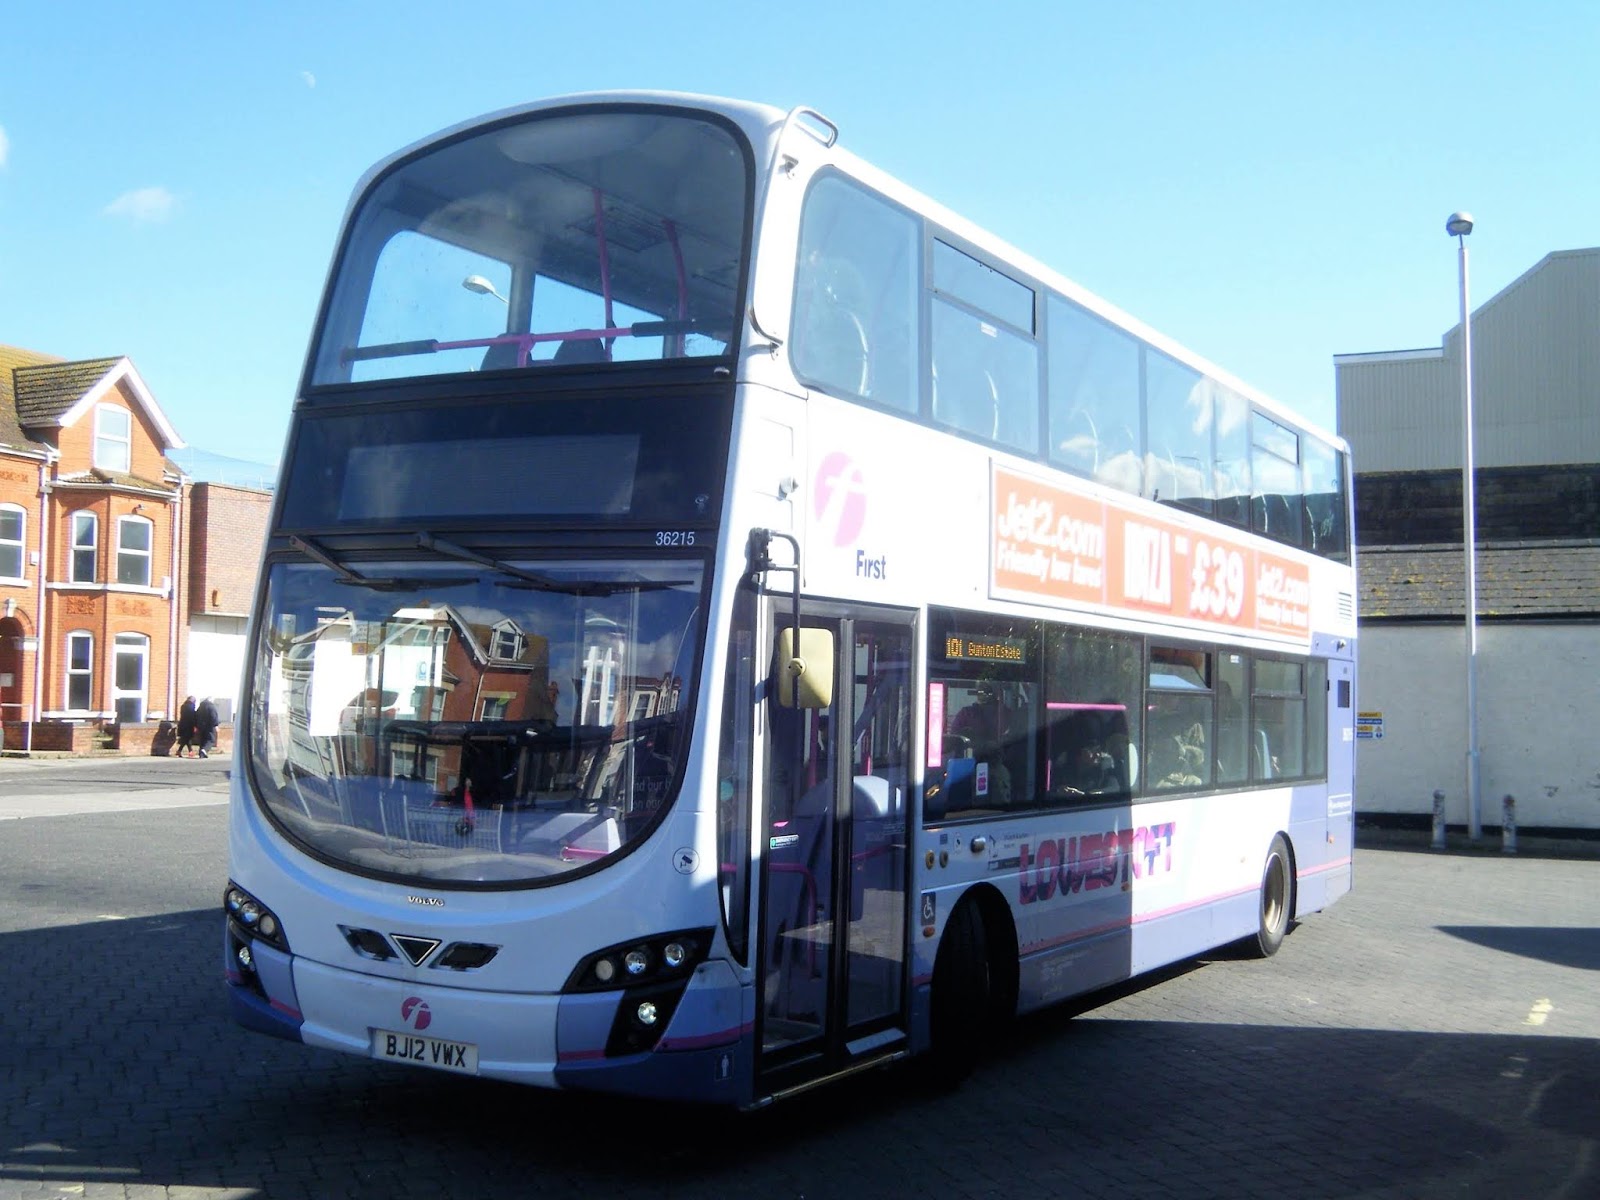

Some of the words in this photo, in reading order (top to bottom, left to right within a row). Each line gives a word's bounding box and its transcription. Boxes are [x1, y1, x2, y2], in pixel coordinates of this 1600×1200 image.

[655, 531, 696, 546] 36215
[997, 491, 1103, 560] Jet2.com
[856, 549, 887, 580] First
[1189, 540, 1245, 619] £39
[1019, 821, 1176, 905] LOWESTOFT
[407, 895, 445, 907] VOLVO
[386, 1034, 425, 1061] BJ12
[431, 1041, 466, 1068] VWX
